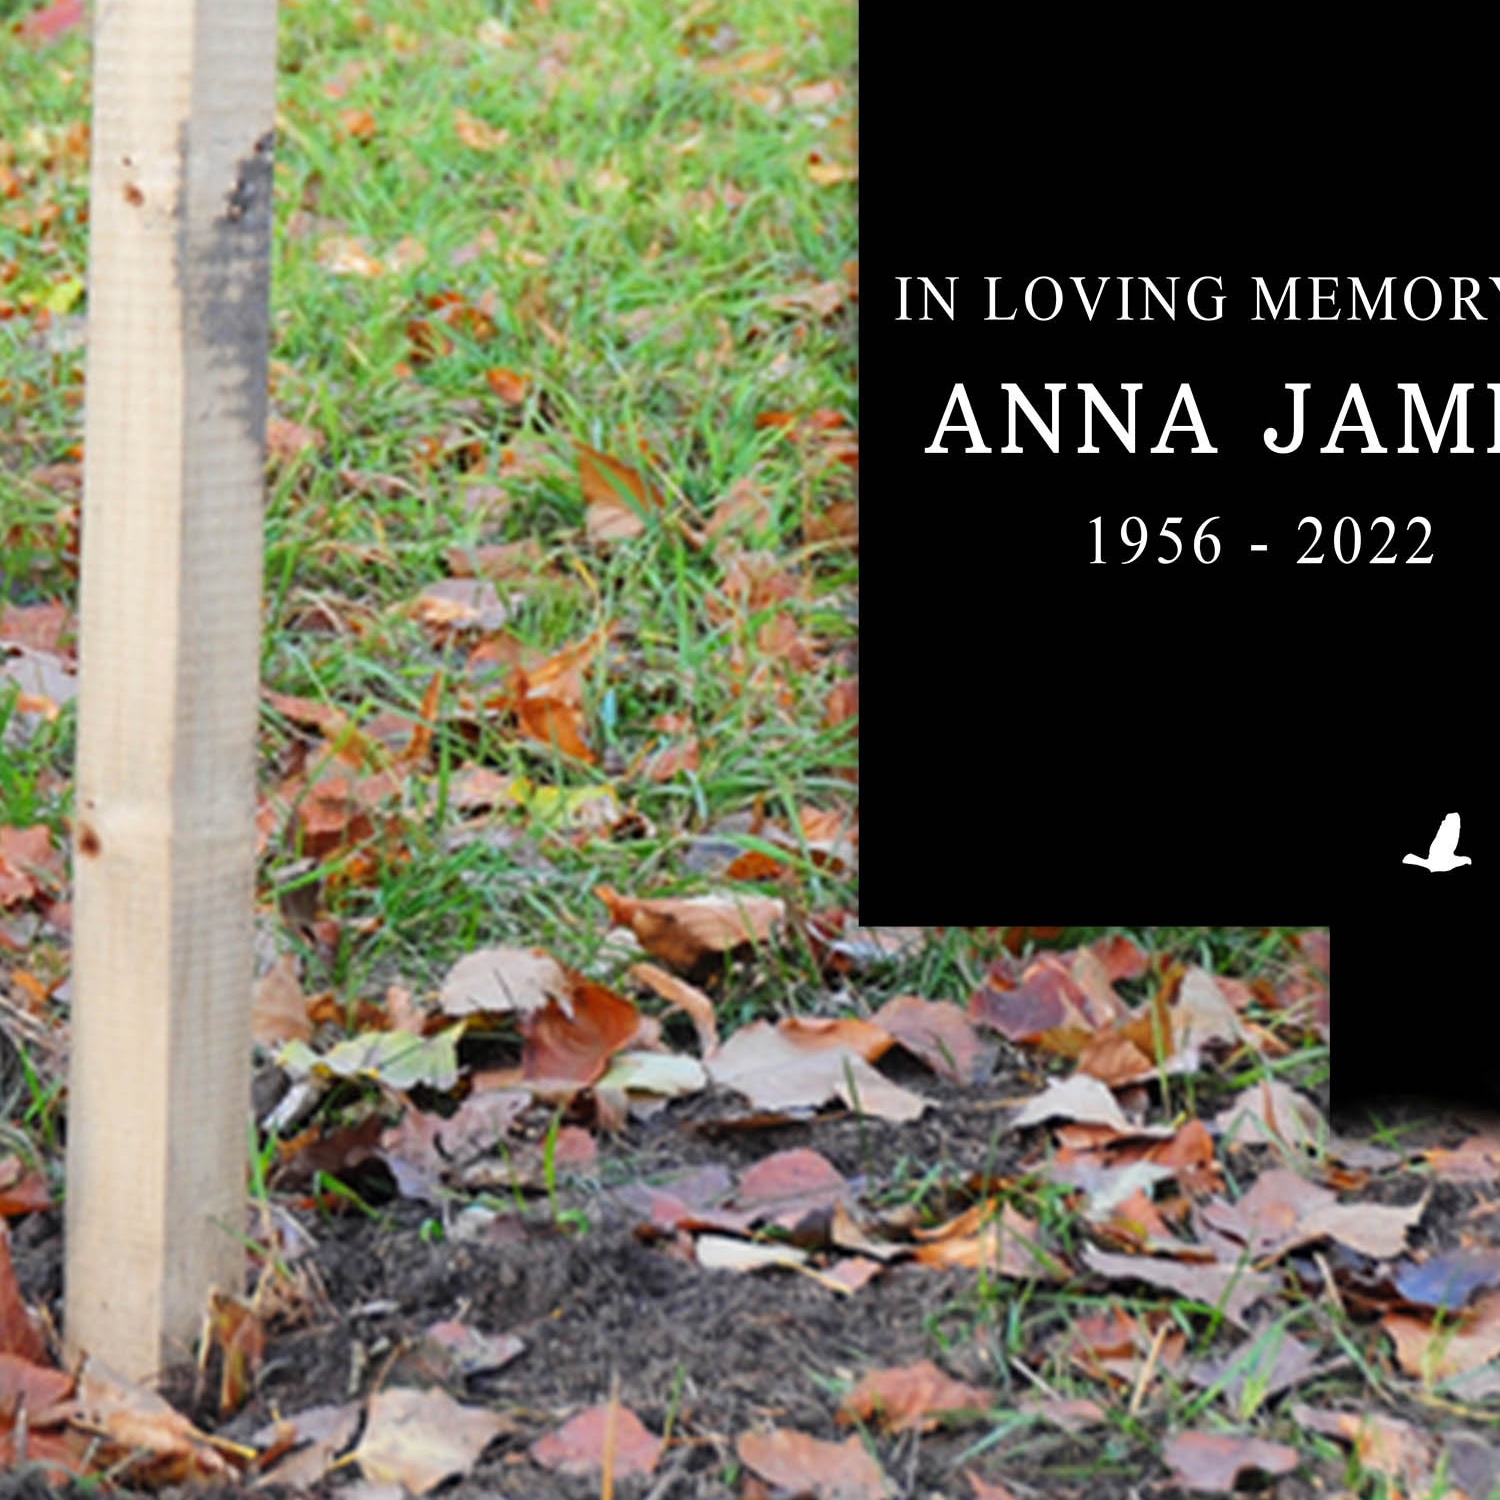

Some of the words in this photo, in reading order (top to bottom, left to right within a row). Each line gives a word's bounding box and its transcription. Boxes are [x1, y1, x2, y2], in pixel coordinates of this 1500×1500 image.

[895, 276, 960, 321] IN
[983, 275, 1227, 322] LOVING
[924, 382, 1219, 454] ANNA
[1089, 515, 1221, 565] 1956
[1296, 515, 1434, 565] 2022
